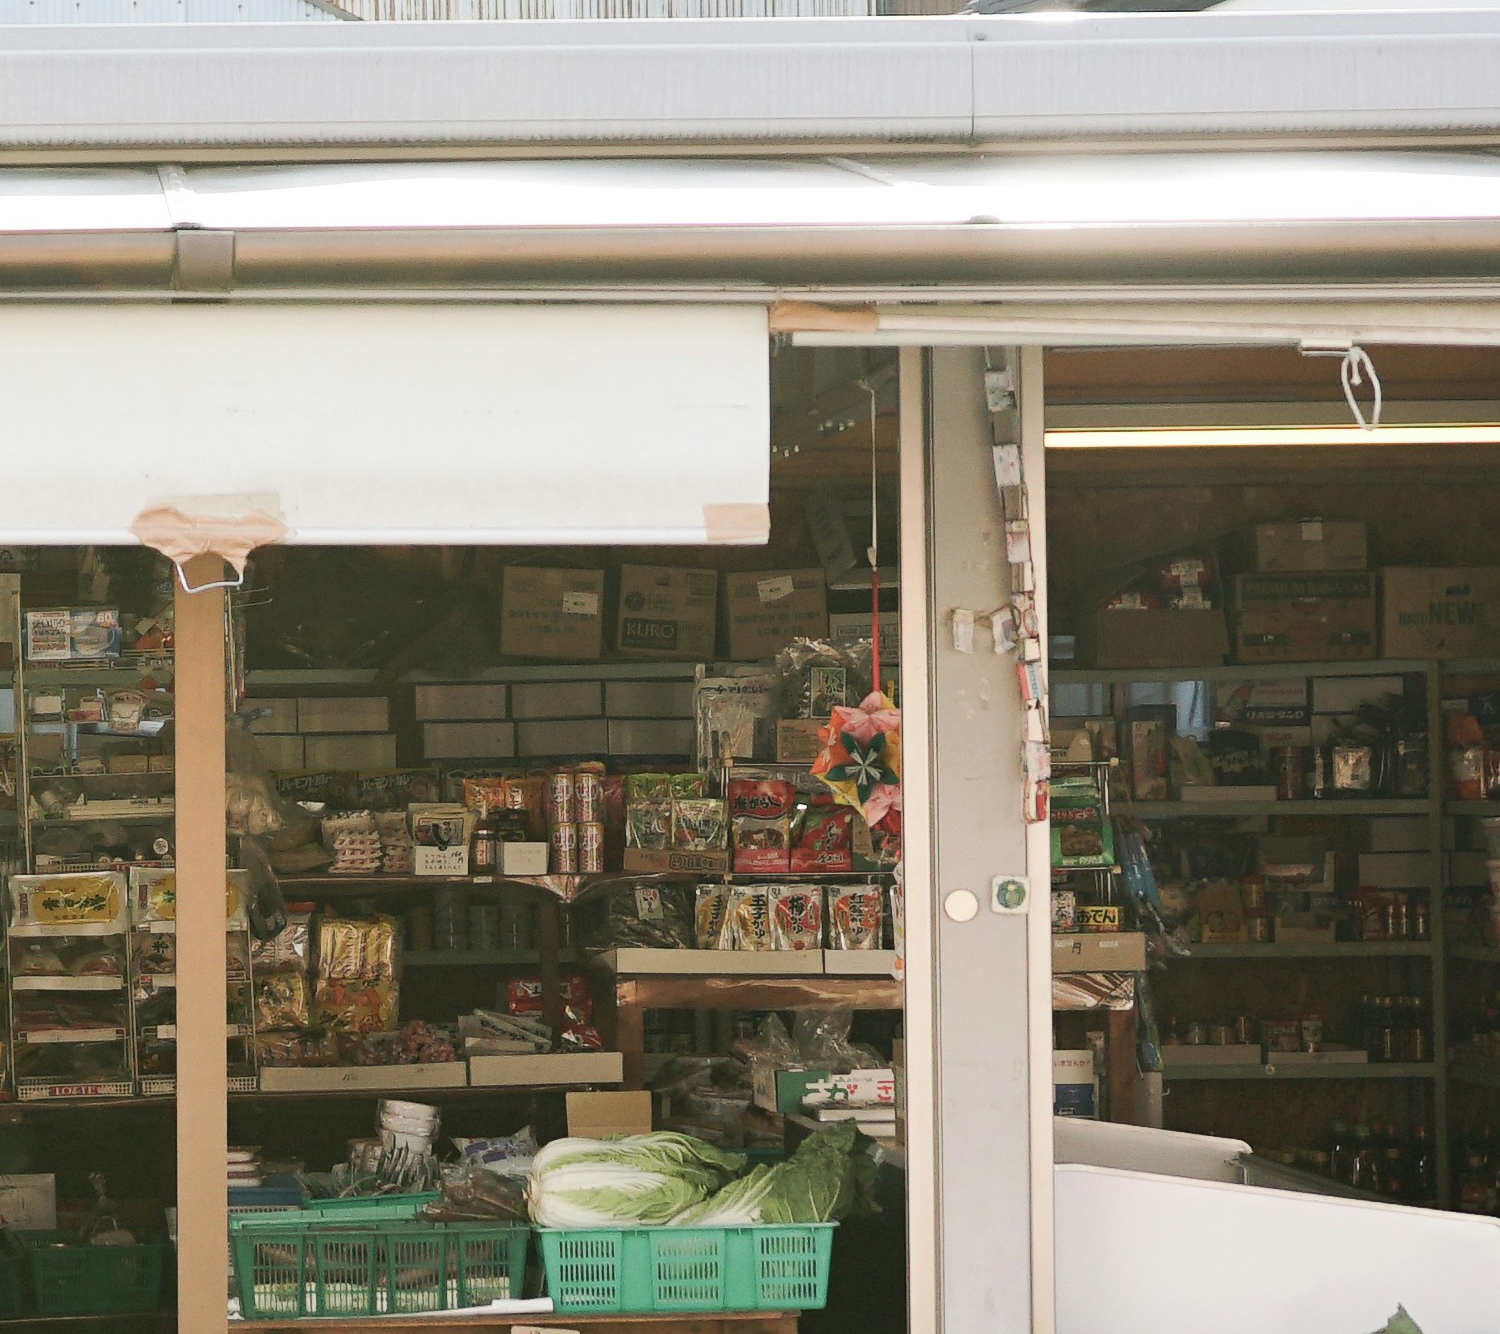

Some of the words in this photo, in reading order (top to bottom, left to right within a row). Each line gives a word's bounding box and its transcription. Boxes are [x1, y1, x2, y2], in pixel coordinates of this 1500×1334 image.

[750, 894, 766, 939] 玉子がゆ
[1077, 908, 1116, 924] おでん
